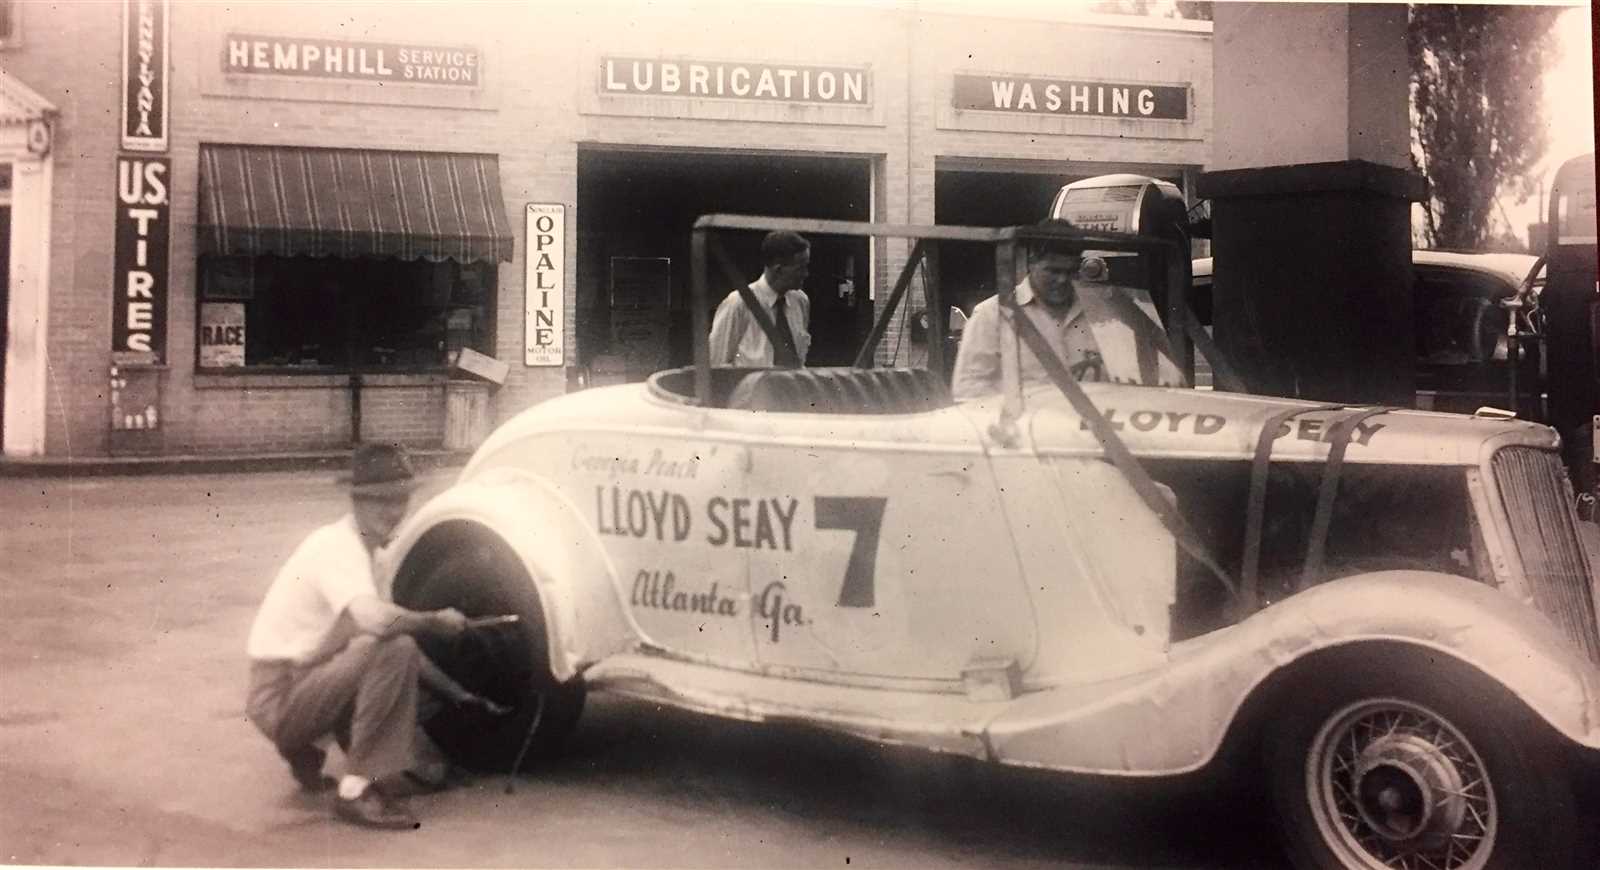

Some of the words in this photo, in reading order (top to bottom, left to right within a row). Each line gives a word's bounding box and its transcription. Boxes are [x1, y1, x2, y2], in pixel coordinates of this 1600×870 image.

[229, 39, 392, 76] HEMPHILL
[399, 48, 477, 67] SERVICE
[403, 64, 472, 81] STATION
[605, 60, 864, 101] LUBRICATION
[991, 80, 1156, 115] WASHING
[1072, 223, 1118, 233] THYL
[127, 208, 158, 352] TIRES
[536, 215, 556, 346] OPALINE
[202, 326, 244, 346] RACE
[1079, 409, 1226, 436] LOYD
[596, 486, 690, 542] LLOYD
[706, 497, 798, 550] SEAY
[814, 496, 888, 608] 7
[631, 568, 737, 617] Atlanta
